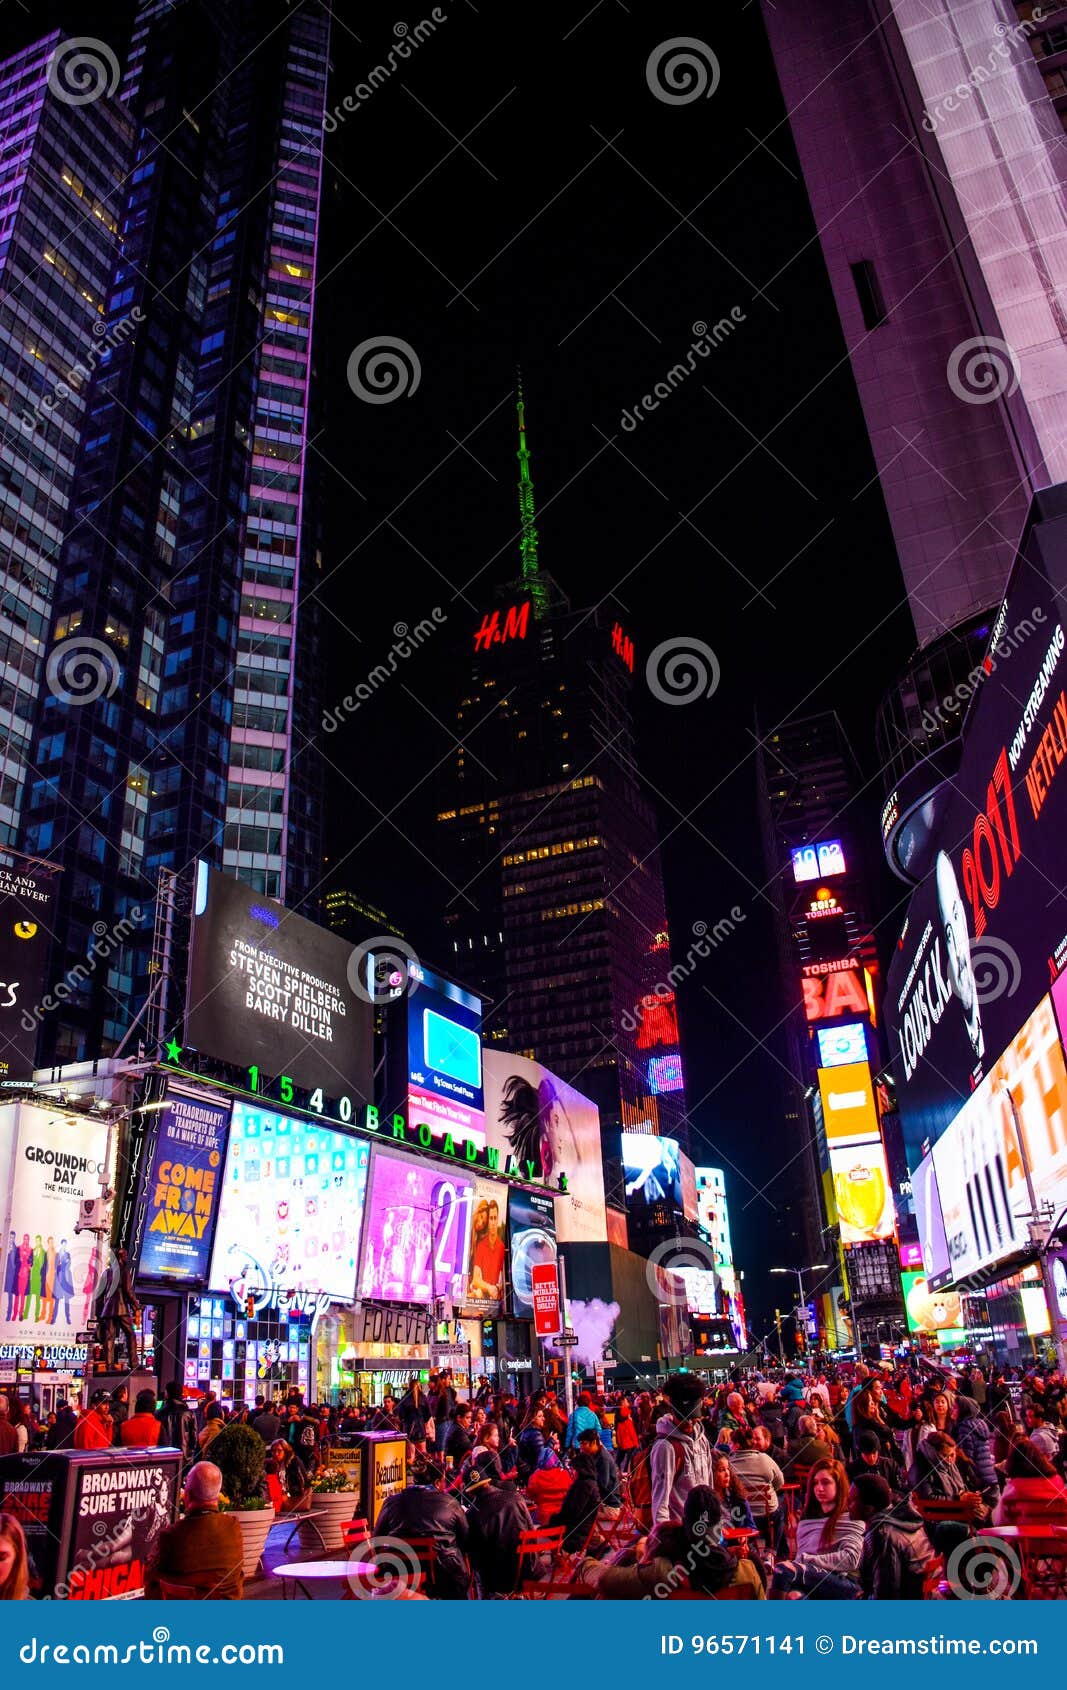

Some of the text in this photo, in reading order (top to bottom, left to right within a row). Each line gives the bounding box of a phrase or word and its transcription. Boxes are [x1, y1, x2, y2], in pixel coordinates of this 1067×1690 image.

[473, 601, 530, 652] H&M
[611, 622, 634, 673] H&M
[1008, 624, 1066, 771] NOW STREAMING
[961, 745, 1021, 943] 2017
[14, 876, 36, 888] AND
[805, 906, 843, 919] TOSHIBA
[810, 898, 836, 912] 2017
[230, 950, 346, 1016] STEVEN SPIELBERG
[234, 939, 341, 997] FROM EXECUTIVE PRODUCERS
[803, 957, 860, 977] TOSHIBA
[245, 991, 333, 1042] BARRY DILLER
[249, 976, 331, 1025] SCOTT RUDIN
[899, 980, 932, 1083] LOUIS
[44, 1182, 84, 1197] THE MUSICAL
[53, 1167, 77, 1186] DAY
[158, 1160, 216, 1194] COME
[154, 1183, 213, 1217] FROM
[149, 1207, 210, 1239] AWAY
[362, 1307, 433, 1345] FOREVER
[0, 1345, 35, 1359] GIFTS
[4, 1481, 53, 1493] BROADWAY'S
[82, 1468, 164, 1494] BROADWAY'S
[376, 1457, 404, 1486] Beautiful
[79, 1488, 157, 1517] SURE THING
[67, 1558, 146, 1600] CHICA
